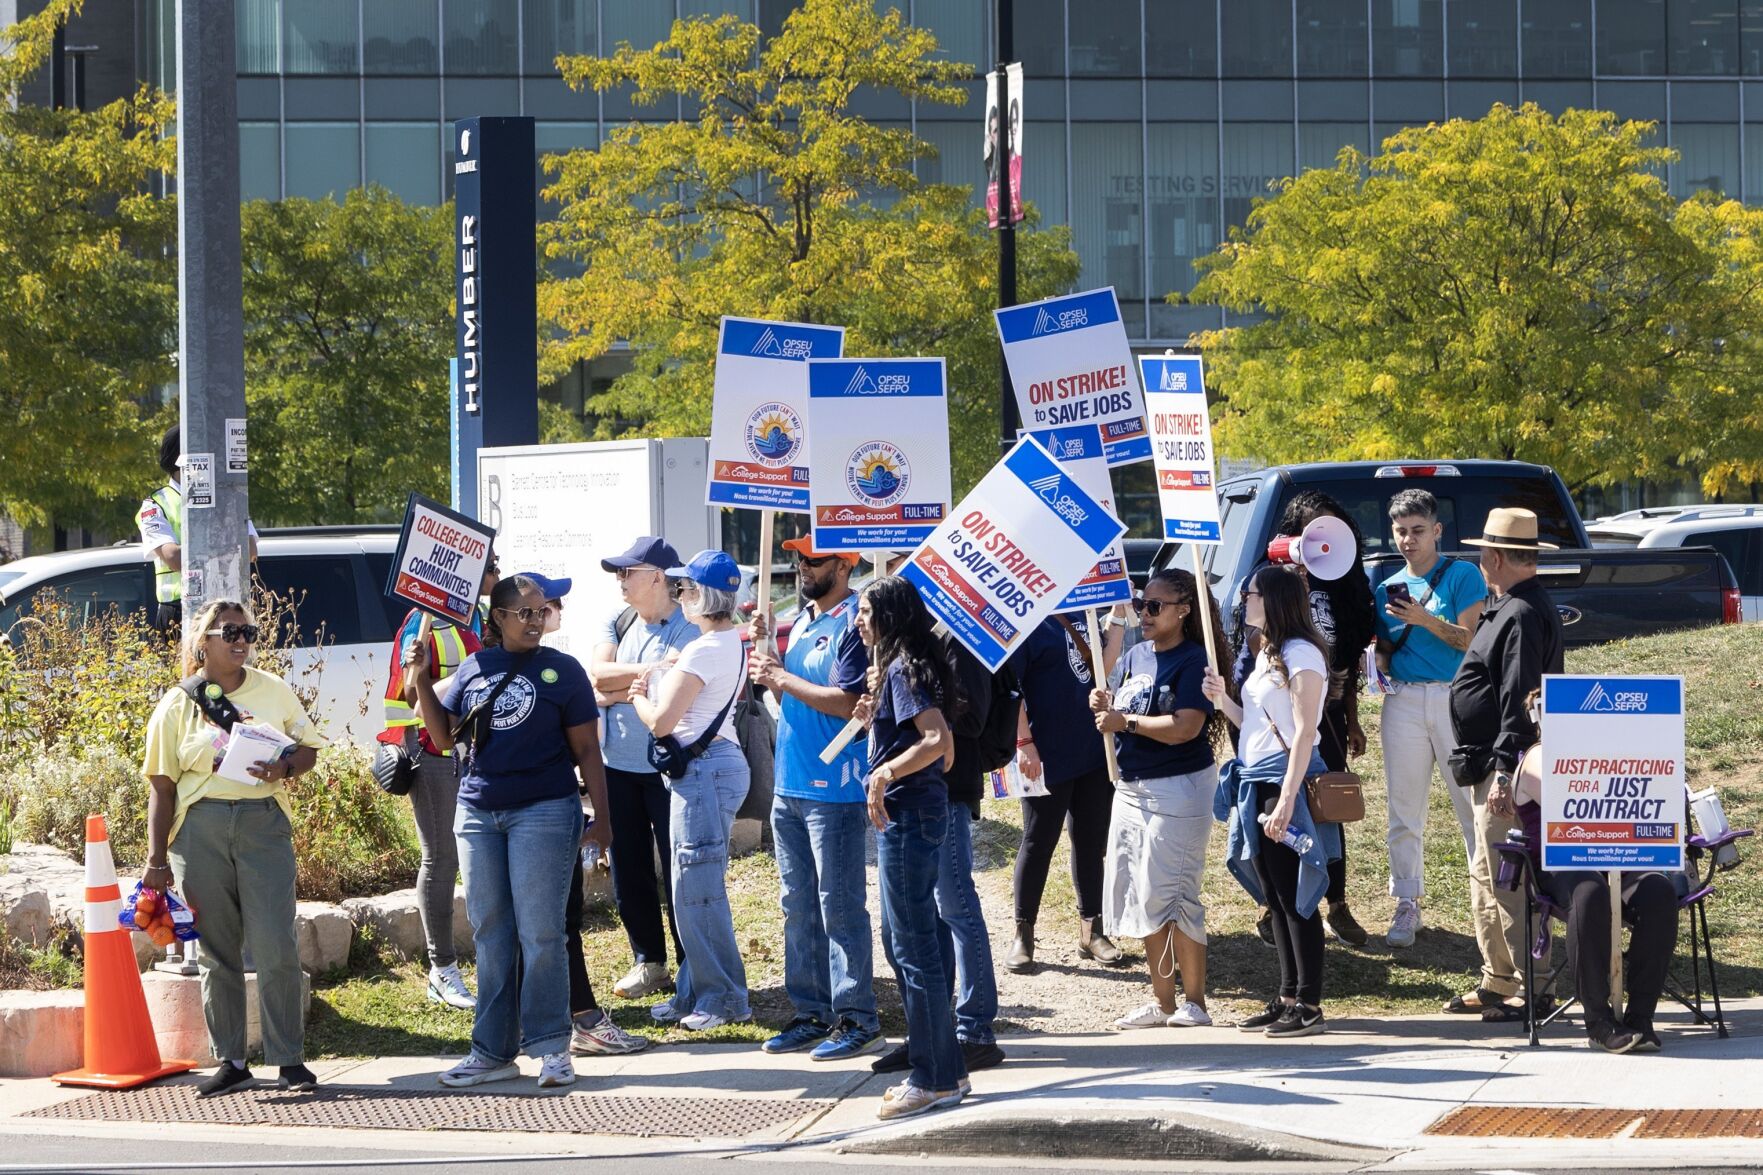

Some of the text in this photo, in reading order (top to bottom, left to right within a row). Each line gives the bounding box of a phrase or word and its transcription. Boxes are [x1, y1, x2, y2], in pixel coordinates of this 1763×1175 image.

[1111, 176, 1195, 193] TESTING
[462, 215, 478, 412] HUMBER
[1058, 308, 1086, 320] OPSEU
[1060, 316, 1088, 329] SEFPO
[782, 348, 810, 358] SEFPO
[783, 338, 812, 350] OPSEU
[878, 375, 910, 384] OPSEU
[1029, 365, 1126, 405] ON STRIKE!
[1171, 373, 1186, 382] OPSEU
[1171, 381, 1187, 390] SEFPO
[878, 384, 910, 394] SEFPO
[752, 411, 761, 422] OUR
[760, 404, 780, 414] FUTURE
[791, 416, 800, 430] WAIT
[1034, 390, 1132, 426] to SAVE JOBS
[1108, 420, 1142, 436] FULL-TIME
[1154, 414, 1203, 435] ON STRIKE!
[1064, 438, 1083, 448] OPSEU
[1065, 447, 1084, 457] SEFPO
[1158, 440, 1206, 460] to SAVE JOBS
[852, 443, 906, 466] OUR FUTURE CAN'T WAIT
[732, 466, 758, 479] College
[760, 472, 787, 480] Support
[850, 484, 864, 500] AVENIR
[884, 496, 897, 505] PLUS
[896, 474, 908, 497] ATTENDRE
[835, 506, 940, 521] College Support FULL-TIME
[1052, 500, 1082, 527] SEFPO
[1060, 495, 1089, 522] OPSEU
[417, 516, 486, 560] COLLEGE CUTS
[428, 544, 463, 572] HURT
[961, 510, 1057, 599] ON STRIKE!
[408, 556, 472, 598] COMMUNITIES
[947, 530, 1034, 617] to SAVE JOBS
[1100, 562, 1121, 574] FULL-TIME
[408, 582, 470, 615] College Support FULL-TIME
[931, 564, 1014, 639] College Support FULL-TIME
[920, 586, 932, 599] Nous
[954, 620, 967, 632] pour
[967, 632, 982, 646] vous!
[936, 590, 976, 628] We work for you!
[1614, 692, 1648, 702] OPSEU
[1614, 702, 1646, 712] SEFPO
[494, 720, 507, 728] PEUT
[507, 715, 520, 726] PLUS
[1552, 759, 1675, 776] JUST PRACTICING
[1568, 777, 1652, 798] FOR A JUST
[1564, 798, 1666, 820] CONTRACT
[1566, 826, 1672, 840] College Support FULL-TIME
